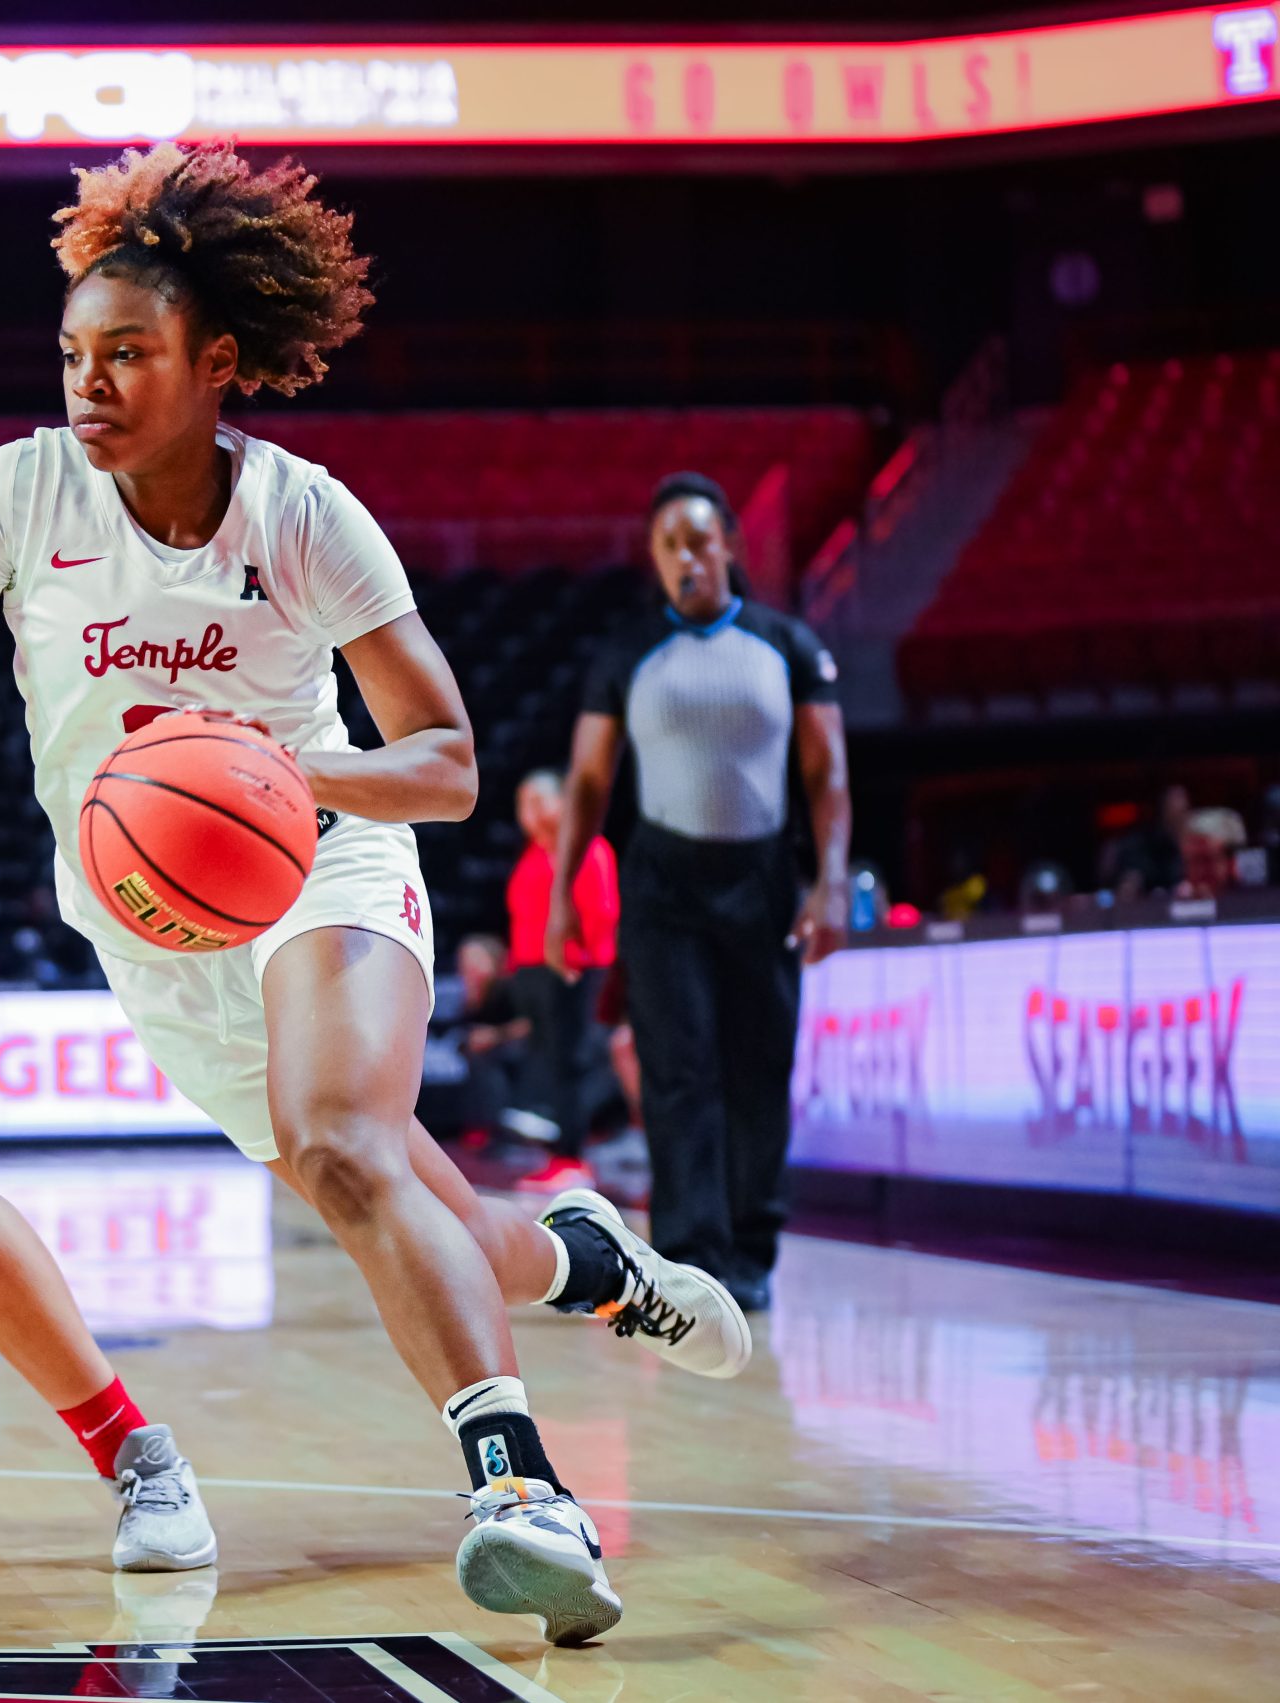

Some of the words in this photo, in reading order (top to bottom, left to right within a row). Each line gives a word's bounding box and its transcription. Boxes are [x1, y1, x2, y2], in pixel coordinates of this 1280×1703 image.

[624, 60, 715, 133] GO
[782, 47, 1032, 134] OWLS!
[82, 615, 238, 684] Temple
[1027, 976, 1246, 1164] SEATGEEK
